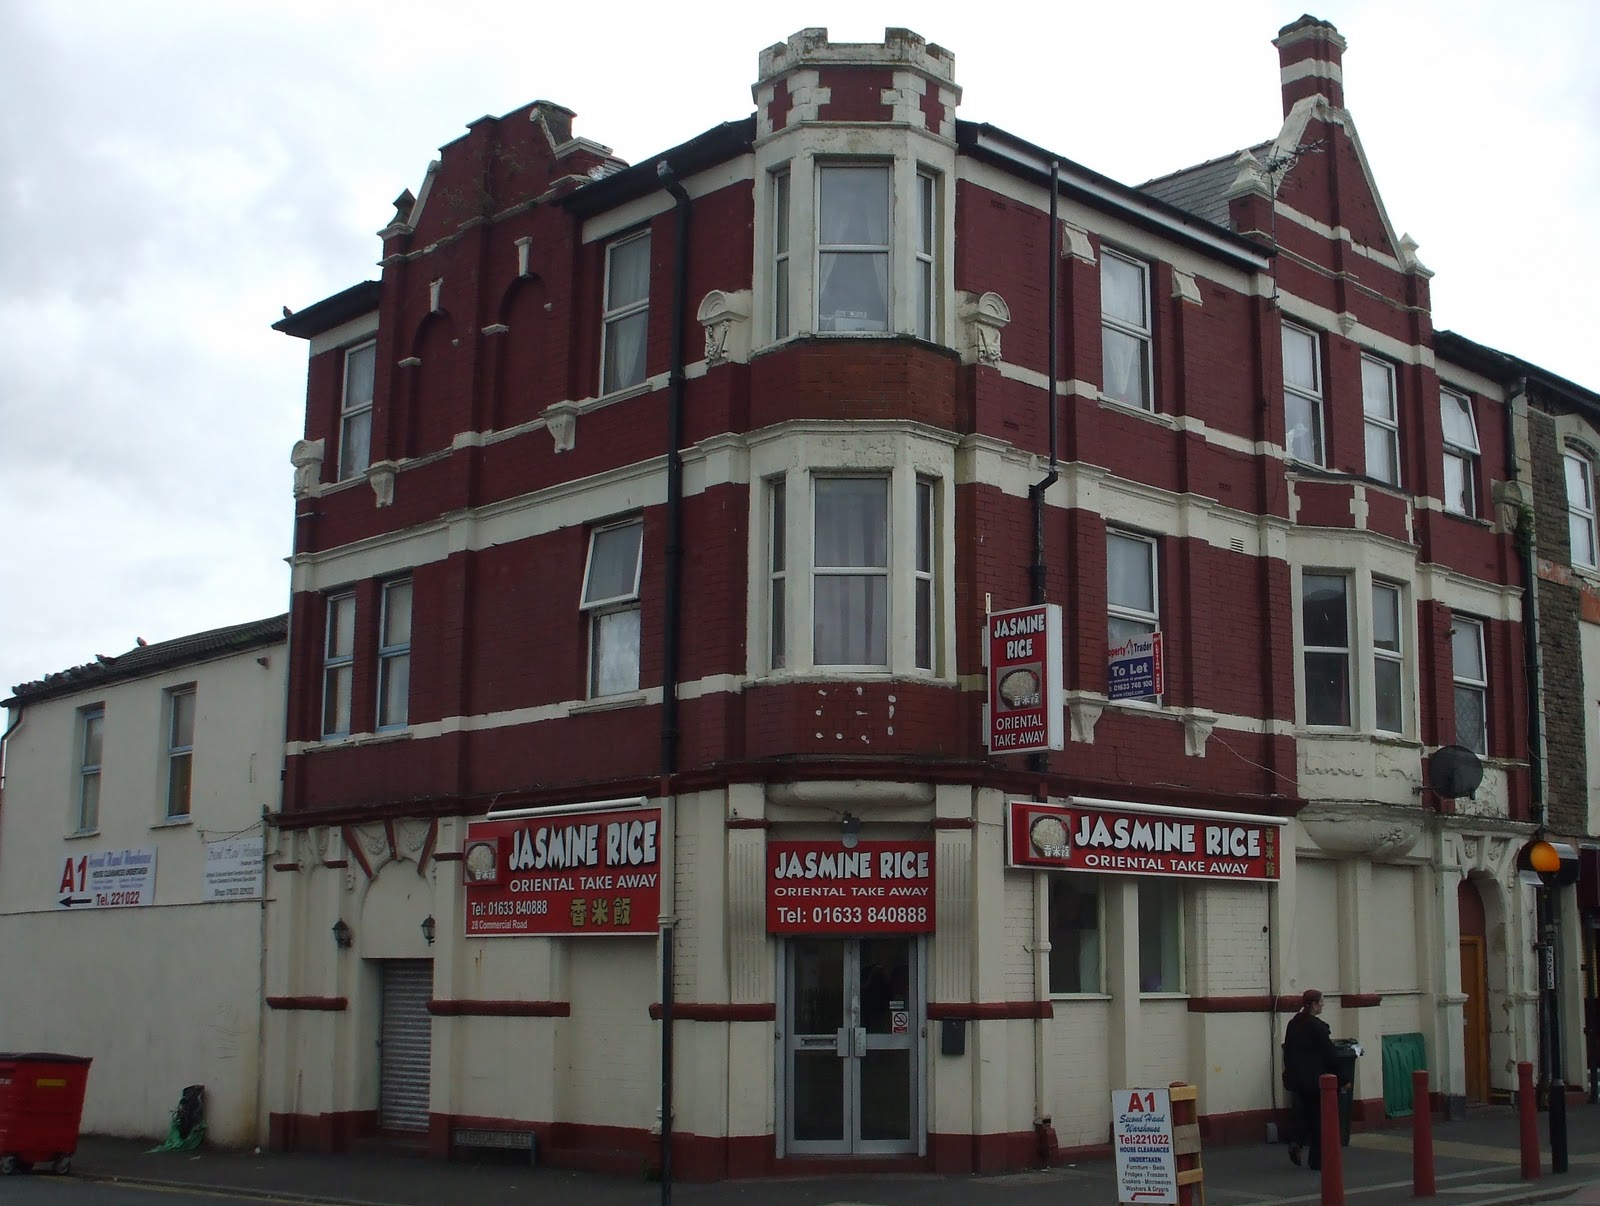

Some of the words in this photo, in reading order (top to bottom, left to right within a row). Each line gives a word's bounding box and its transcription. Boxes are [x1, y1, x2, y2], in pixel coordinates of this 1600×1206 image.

[994, 614, 1045, 638] JASMINE
[1006, 638, 1033, 660] RICE
[1134, 642, 1152, 653] Trader
[1111, 665, 1126, 677] To
[1129, 662, 1148, 675] Let
[996, 715, 1043, 730] ORIENTAL
[994, 733, 1016, 747] TAKE
[1018, 731, 1045, 744] AWAY
[1075, 815, 1196, 853] JASMINE
[1206, 826, 1261, 858] RICE
[509, 824, 599, 871] JASMINE
[606, 820, 657, 866] RICE
[774, 851, 872, 879] JASMINE
[880, 851, 929, 879] RICE
[1085, 854, 1165, 870] ORIENTAL
[1170, 859, 1205, 872] TAKE
[1209, 862, 1248, 875] AWAY
[59, 855, 88, 893] A1
[509, 877, 575, 893] ORIENTAL
[580, 876, 612, 890] TAKE
[616, 874, 657, 889] AWAY
[110, 891, 140, 905] 221022
[774, 887, 846, 897] ORIENTAL
[851, 887, 885, 896] TAKE
[889, 887, 929, 896] AWAY
[471, 902, 486, 916] Tel:
[488, 901, 513, 916] 01633
[515, 900, 548, 915] 840888
[570, 897, 631, 927] 香米飯
[777, 907, 807, 923] Tel:
[812, 907, 863, 923] 01633
[867, 907, 928, 923] 840888
[479, 919, 512, 930] Commercial
[512, 920, 528, 930] Road
[1128, 1092, 1156, 1112] A1
[1119, 1114, 1143, 1123] Second
[1144, 1113, 1165, 1123] Hand
[1125, 1123, 1160, 1133] Warehouse
[1119, 1134, 1169, 1145] Tel:221022
